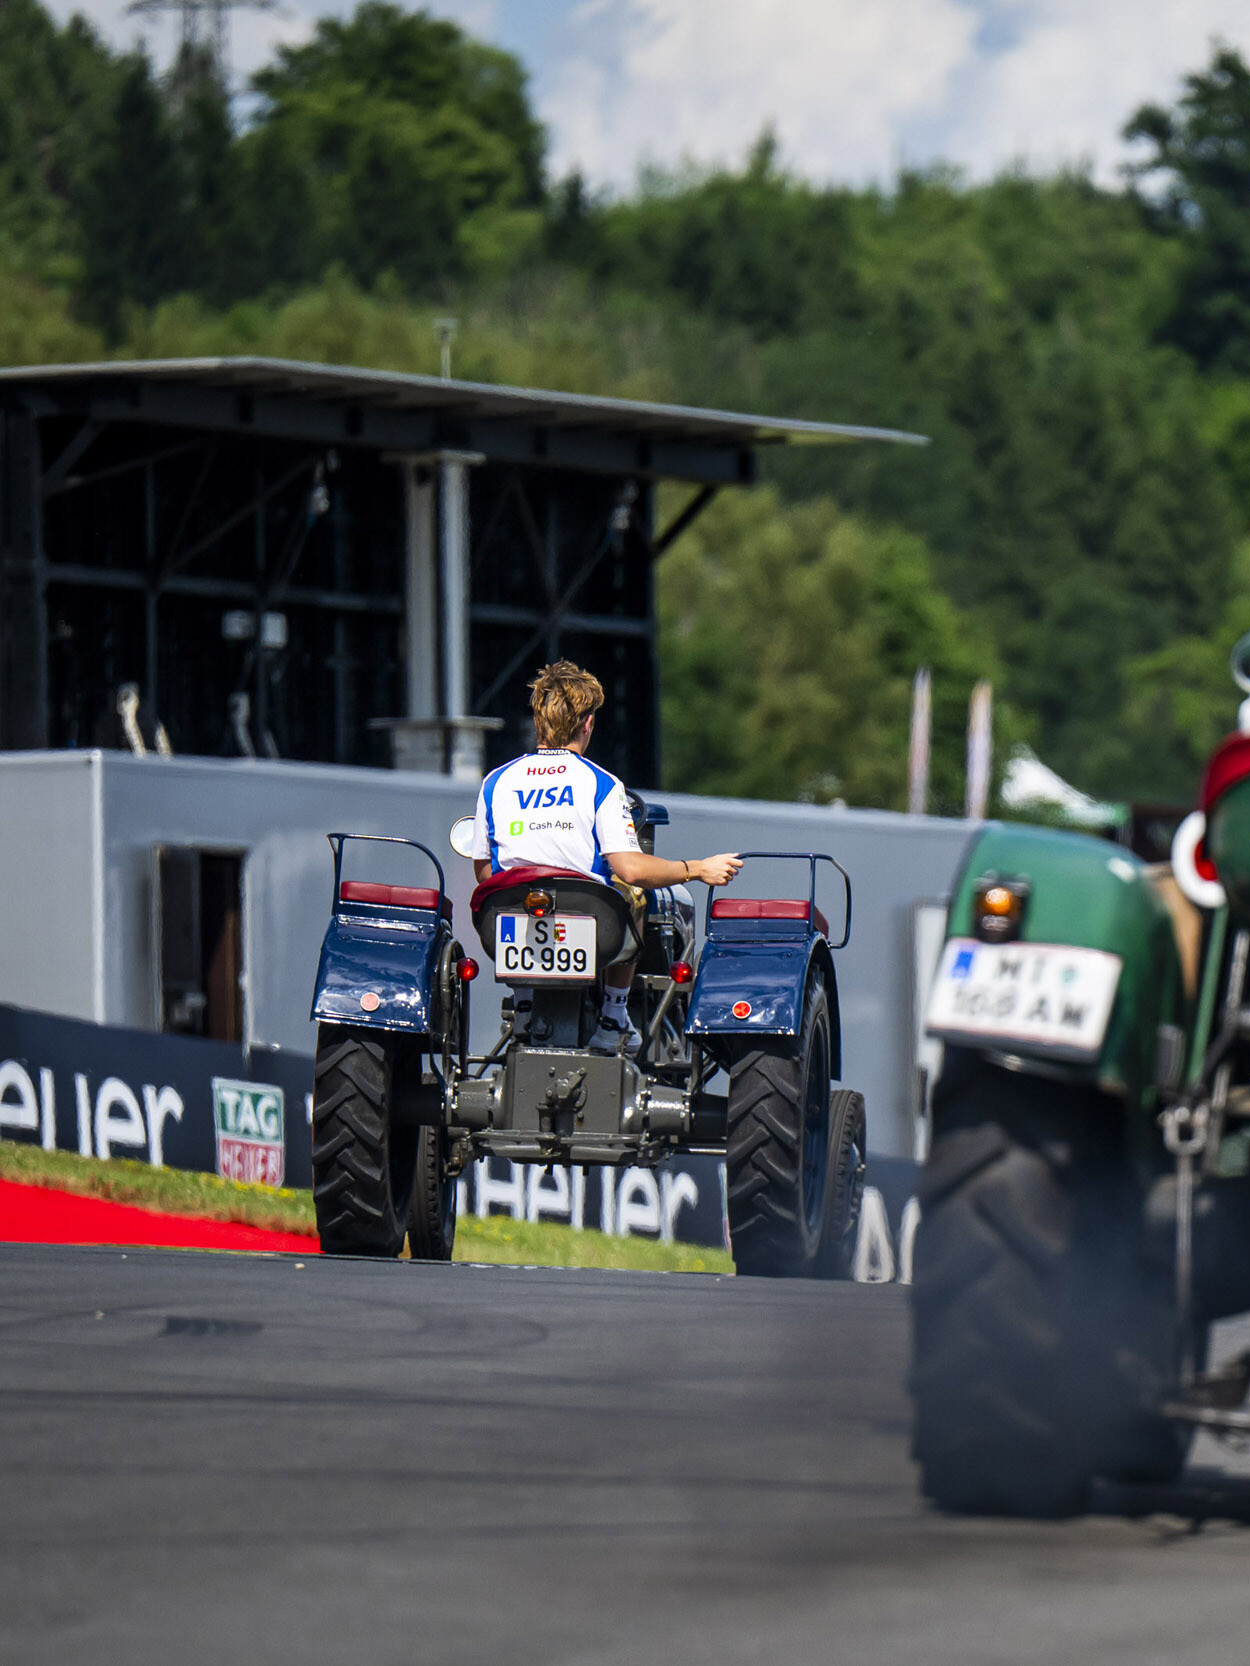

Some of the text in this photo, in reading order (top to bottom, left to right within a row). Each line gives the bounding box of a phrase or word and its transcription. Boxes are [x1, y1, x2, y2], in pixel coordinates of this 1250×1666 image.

[527, 765, 567, 775] HUGO
[512, 785, 574, 809] VISA
[528, 821, 552, 831] Cash
[554, 820, 575, 831] App
[503, 933, 513, 942] A
[534, 920, 548, 944] S
[505, 946, 586, 972] CC 999
[0, 1059, 184, 1168] euer
[220, 1090, 280, 1138] TAG
